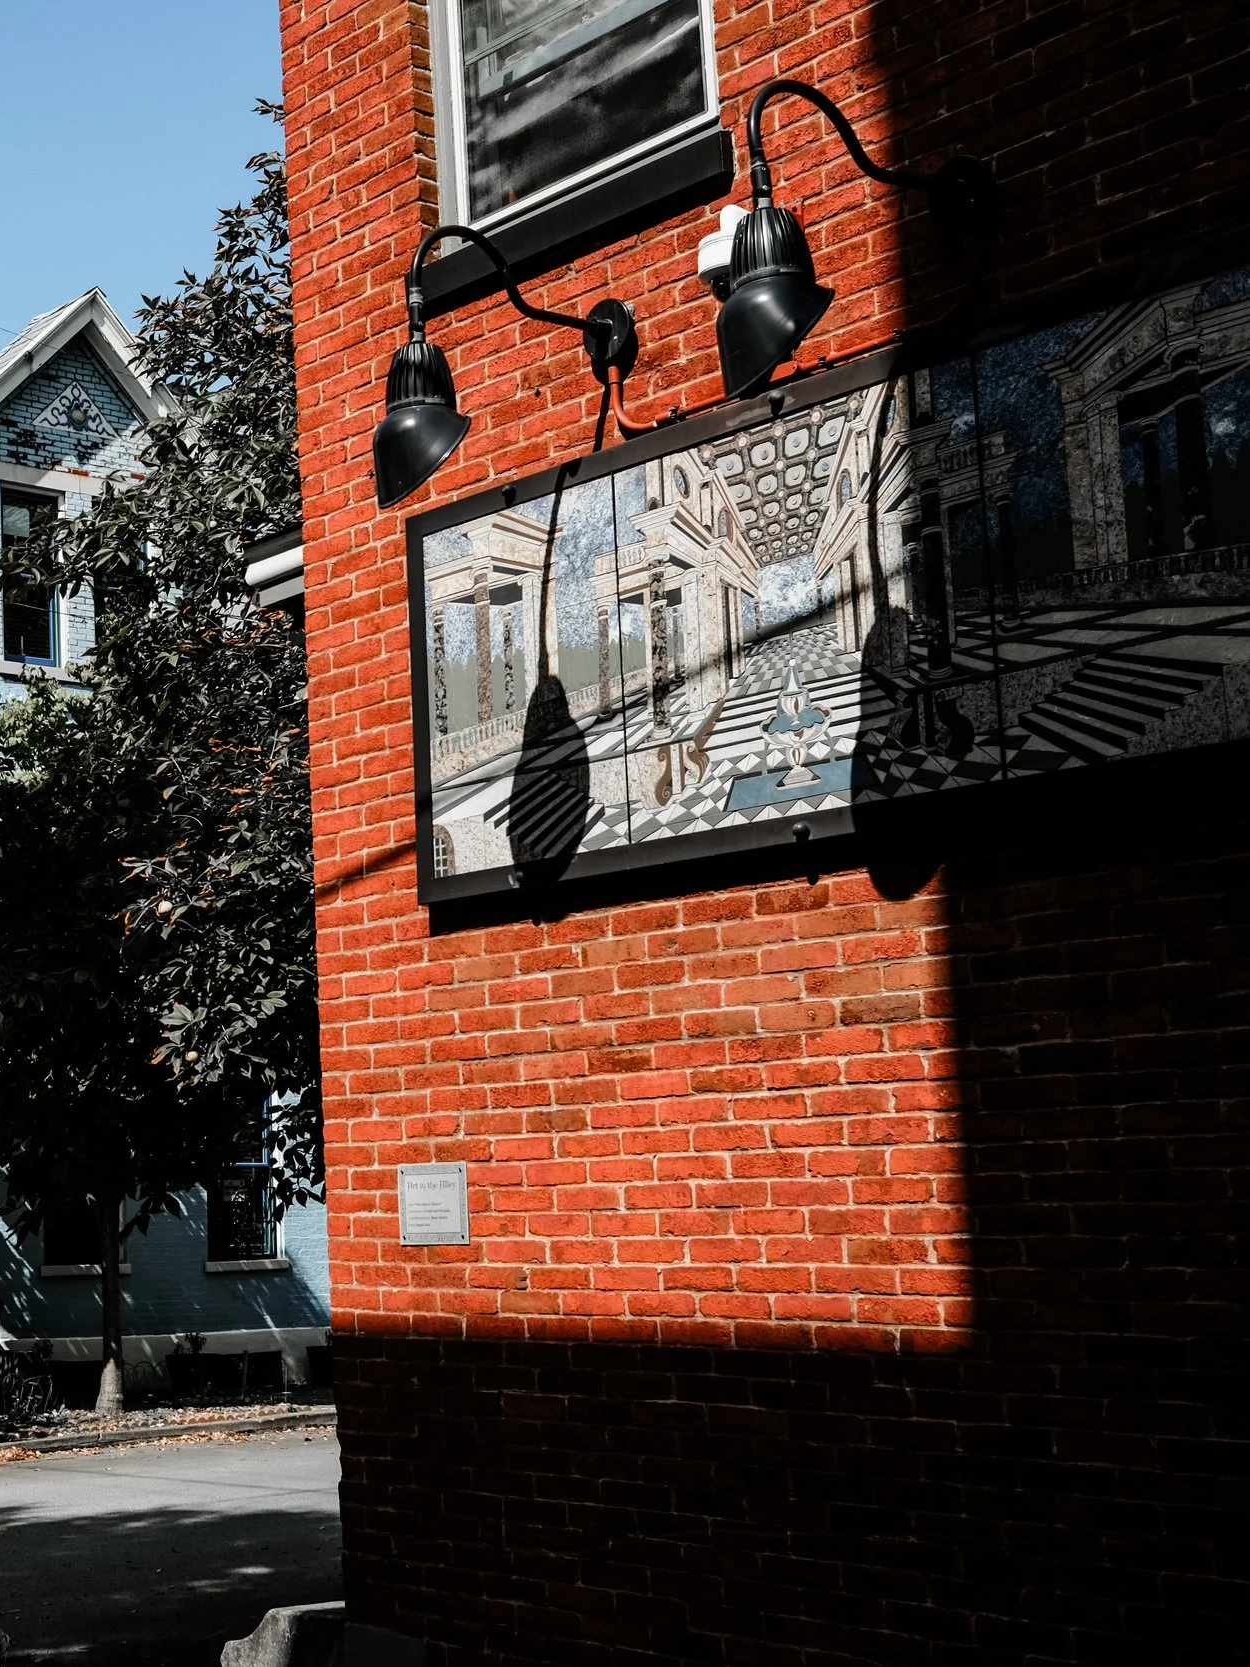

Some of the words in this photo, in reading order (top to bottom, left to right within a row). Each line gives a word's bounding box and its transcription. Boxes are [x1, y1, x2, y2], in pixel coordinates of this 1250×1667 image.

[407, 1181, 418, 1192] Art
[419, 1181, 427, 1192] in
[427, 1180, 438, 1191] the
[438, 1179, 456, 1191] Alley
